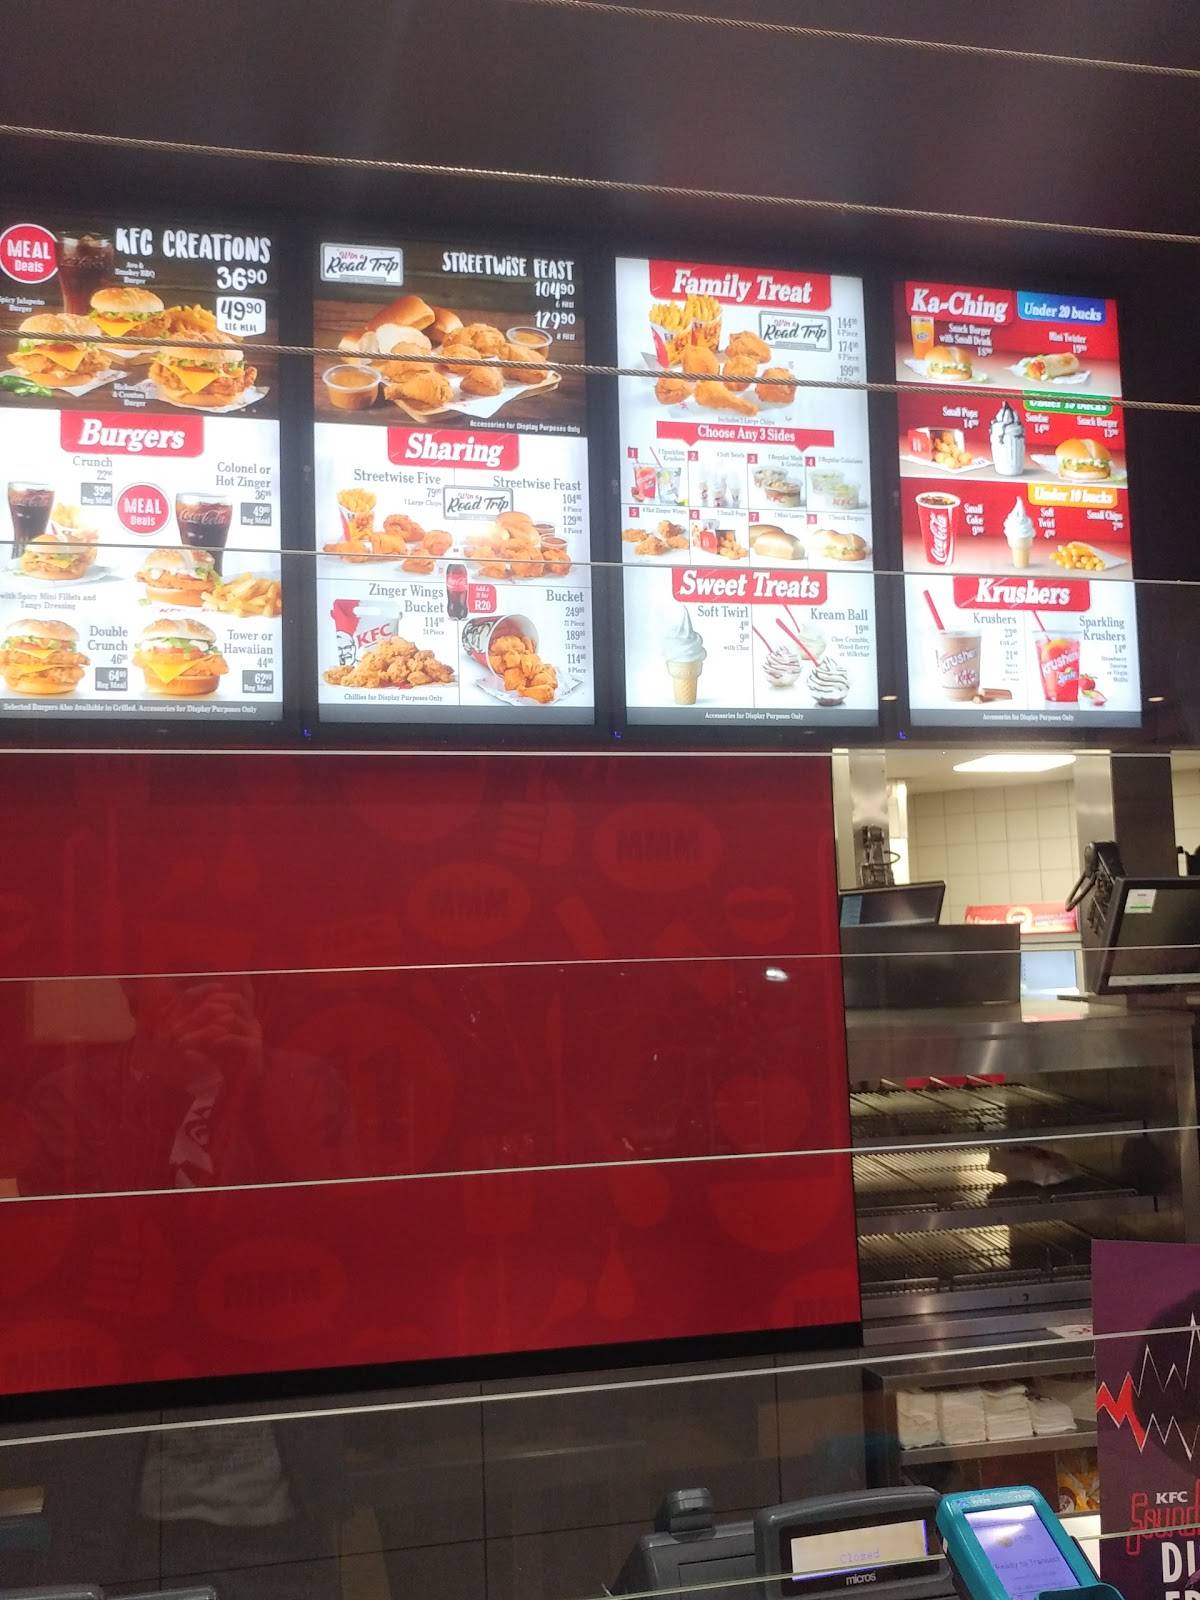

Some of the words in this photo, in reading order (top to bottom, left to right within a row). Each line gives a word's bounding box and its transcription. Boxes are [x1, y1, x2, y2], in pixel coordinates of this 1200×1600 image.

[116, 227, 153, 256] KFC
[7, 239, 51, 260] MEAL
[15, 260, 44, 273] Deals
[326, 256, 368, 274] Road
[369, 256, 399, 276] Trip
[533, 258, 575, 280] FEAST
[672, 269, 751, 302] Family
[757, 275, 812, 304] Treat
[911, 288, 1008, 322] Ka-Ching
[1024, 302, 1057, 317] Under
[1058, 304, 1070, 318] 20
[1071, 306, 1102, 321] bucks
[764, 322, 800, 341] Road
[801, 323, 827, 342] Trip
[954, 335, 972, 344] Small
[973, 335, 991, 346] Drink
[943, 406, 960, 417] Small
[506, 421, 515, 429] for
[516, 422, 538, 431] Display
[539, 423, 566, 432] Purposes
[567, 425, 580, 433] Only
[698, 425, 735, 438] Choose
[738, 426, 758, 441] Any
[760, 428, 766, 440] 3
[767, 429, 795, 441] Sides
[78, 418, 185, 452] Burgers
[404, 432, 504, 467] Sharing
[690, 451, 696, 459] 2
[72, 456, 112, 467] Crunch
[808, 458, 813, 466] 4
[217, 462, 257, 474] Colonel
[259, 466, 271, 475] or
[216, 475, 234, 486] Hot
[237, 477, 271, 490] Zinger
[353, 468, 414, 483] Streetwise
[416, 472, 441, 485] Five
[493, 475, 551, 489] Streetwise
[553, 478, 583, 491] Feast
[124, 497, 162, 515] MEAL
[447, 496, 482, 512] Road
[483, 495, 509, 511] Trip
[964, 503, 983, 514] Small
[1041, 507, 1055, 518] Soft
[1087, 509, 1105, 520] Small
[130, 514, 156, 527] Deals
[967, 515, 983, 525] Coke
[1038, 518, 1055, 528] Twirl
[930, 512, 947, 562] Coca-Cola
[680, 569, 747, 597] Sweet
[752, 571, 820, 598] Treats
[369, 583, 407, 598] Zinger
[410, 585, 444, 599] Wings
[546, 589, 584, 602] Bucket
[975, 577, 1070, 605] Krushers
[405, 600, 444, 613] Bucket
[697, 605, 719, 617] Soft
[721, 605, 749, 618] Twirl
[810, 608, 846, 620] Kream
[847, 609, 868, 620] Ball
[973, 612, 1017, 625] Krushers
[1079, 615, 1125, 630] Sparkling
[89, 625, 128, 637] Double
[226, 629, 258, 641] Tower
[261, 631, 273, 641] or
[357, 623, 392, 647] KFC
[1083, 629, 1126, 641] Krushers
[87, 640, 128, 652] Crunch
[224, 642, 273, 655] Hawaiian
[97, 681, 108, 691] Reg
[244, 684, 256, 693] Reg
[257, 684, 272, 692] Meal
[1156, 1491, 1188, 1505] KFC
[840, 1548, 880, 1563] Closed
[846, 1573, 877, 1586] micros
